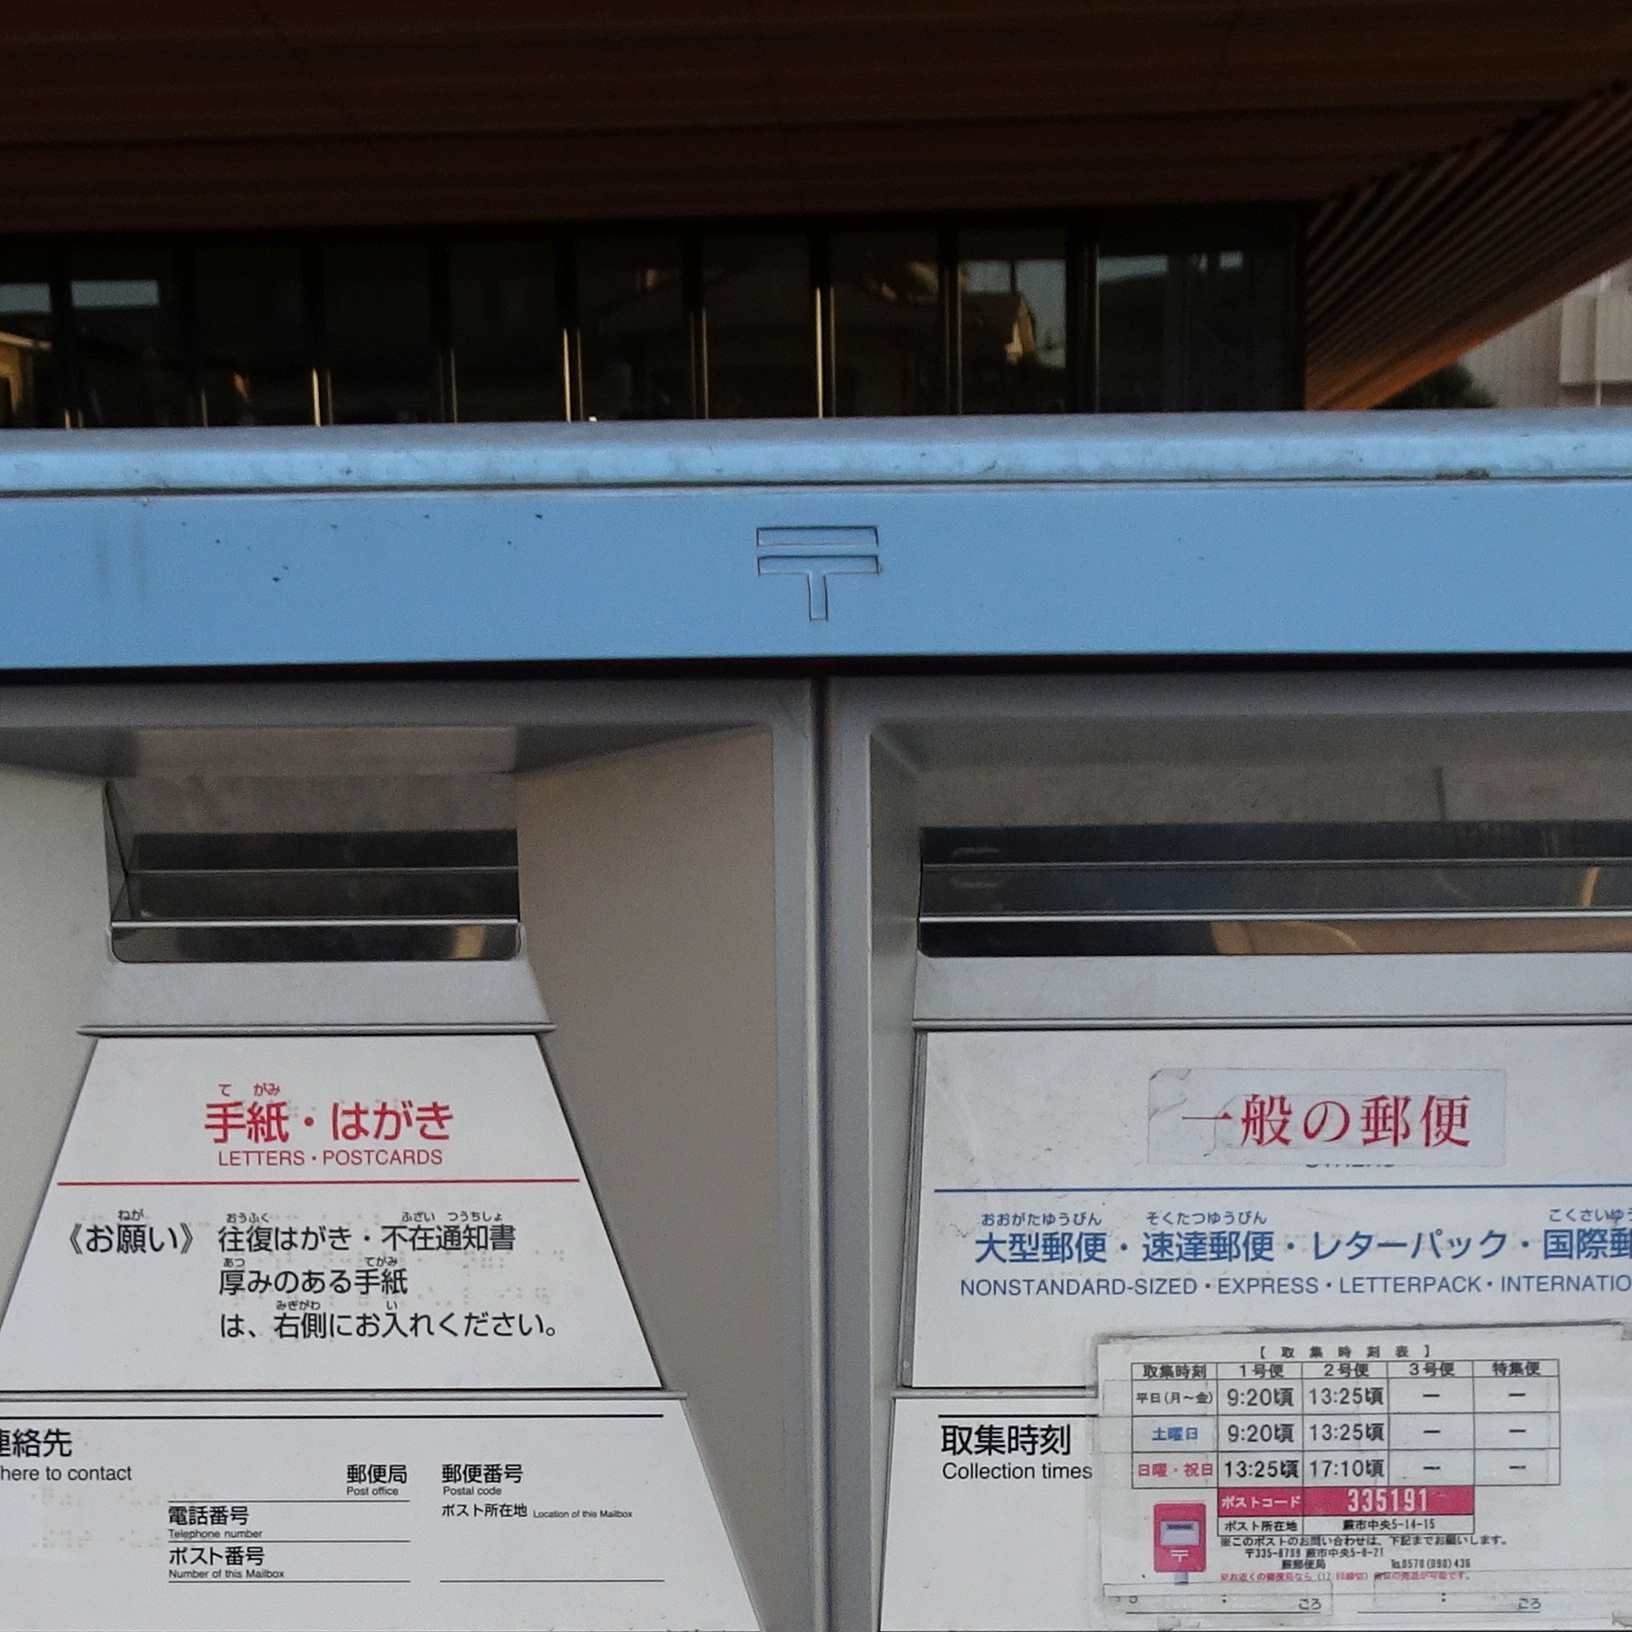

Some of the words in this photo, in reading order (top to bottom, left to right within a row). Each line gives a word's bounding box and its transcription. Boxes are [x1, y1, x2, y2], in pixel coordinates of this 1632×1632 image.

[204, 1101, 454, 1144] 手紙・はがき
[1181, 1093, 1472, 1149] 一般の郵便
[218, 1150, 306, 1166] LETTERS
[322, 1149, 444, 1166] POSTCARDS
[980, 1212, 1103, 1228] おおがたゆうびん
[1146, 1209, 1268, 1226] そくたつゆうびん
[218, 1224, 517, 1254] 往復はがき・不在通知書
[218, 1268, 408, 1296] 厚みのある手紙
[1217, 1276, 1320, 1296] EXPRESS
[1339, 1275, 1482, 1294] LETTERPACK
[220, 1311, 558, 1339] は、右側にお入れください。
[1142, 1363, 1208, 1379] 取集時刻
[1491, 1361, 1542, 1377] 特集便
[1226, 1387, 1295, 1408] 9:20頃
[1308, 1386, 1385, 1407] 13:25頃
[940, 1424, 1071, 1456] 取集時刻
[1151, 1426, 1200, 1442] 土曜日
[1226, 1423, 1295, 1444] 9:20頃
[1308, 1422, 1385, 1443] 13:25頃
[45, 1466, 63, 1482] to
[67, 1465, 133, 1481] contact
[346, 1463, 408, 1485] 郵便局
[441, 1463, 524, 1484] 郵便番号
[942, 1461, 1036, 1480] Collection
[1041, 1462, 1093, 1480] times
[1224, 1459, 1299, 1479] 13:25頃
[1308, 1458, 1385, 1478] 17:10頃
[346, 1486, 369, 1496] Post
[371, 1486, 399, 1496] office
[442, 1486, 474, 1496] Postal
[476, 1486, 502, 1496] code
[1220, 1496, 1303, 1510] ポストコード
[1347, 1488, 1429, 1513] 335191
[168, 1505, 249, 1527] 電話番号
[441, 1502, 528, 1518] ポスト所在地
[532, 1509, 569, 1518] Location
[599, 1509, 633, 1518] Mailbox
[168, 1528, 221, 1540] Telephone
[224, 1528, 263, 1539] number
[1223, 1519, 1299, 1532] ポスト所在地
[168, 1546, 265, 1566] ポスト番号
[168, 1568, 209, 1579] Number
[224, 1568, 242, 1579] this
[246, 1568, 285, 1579] Mailbox
